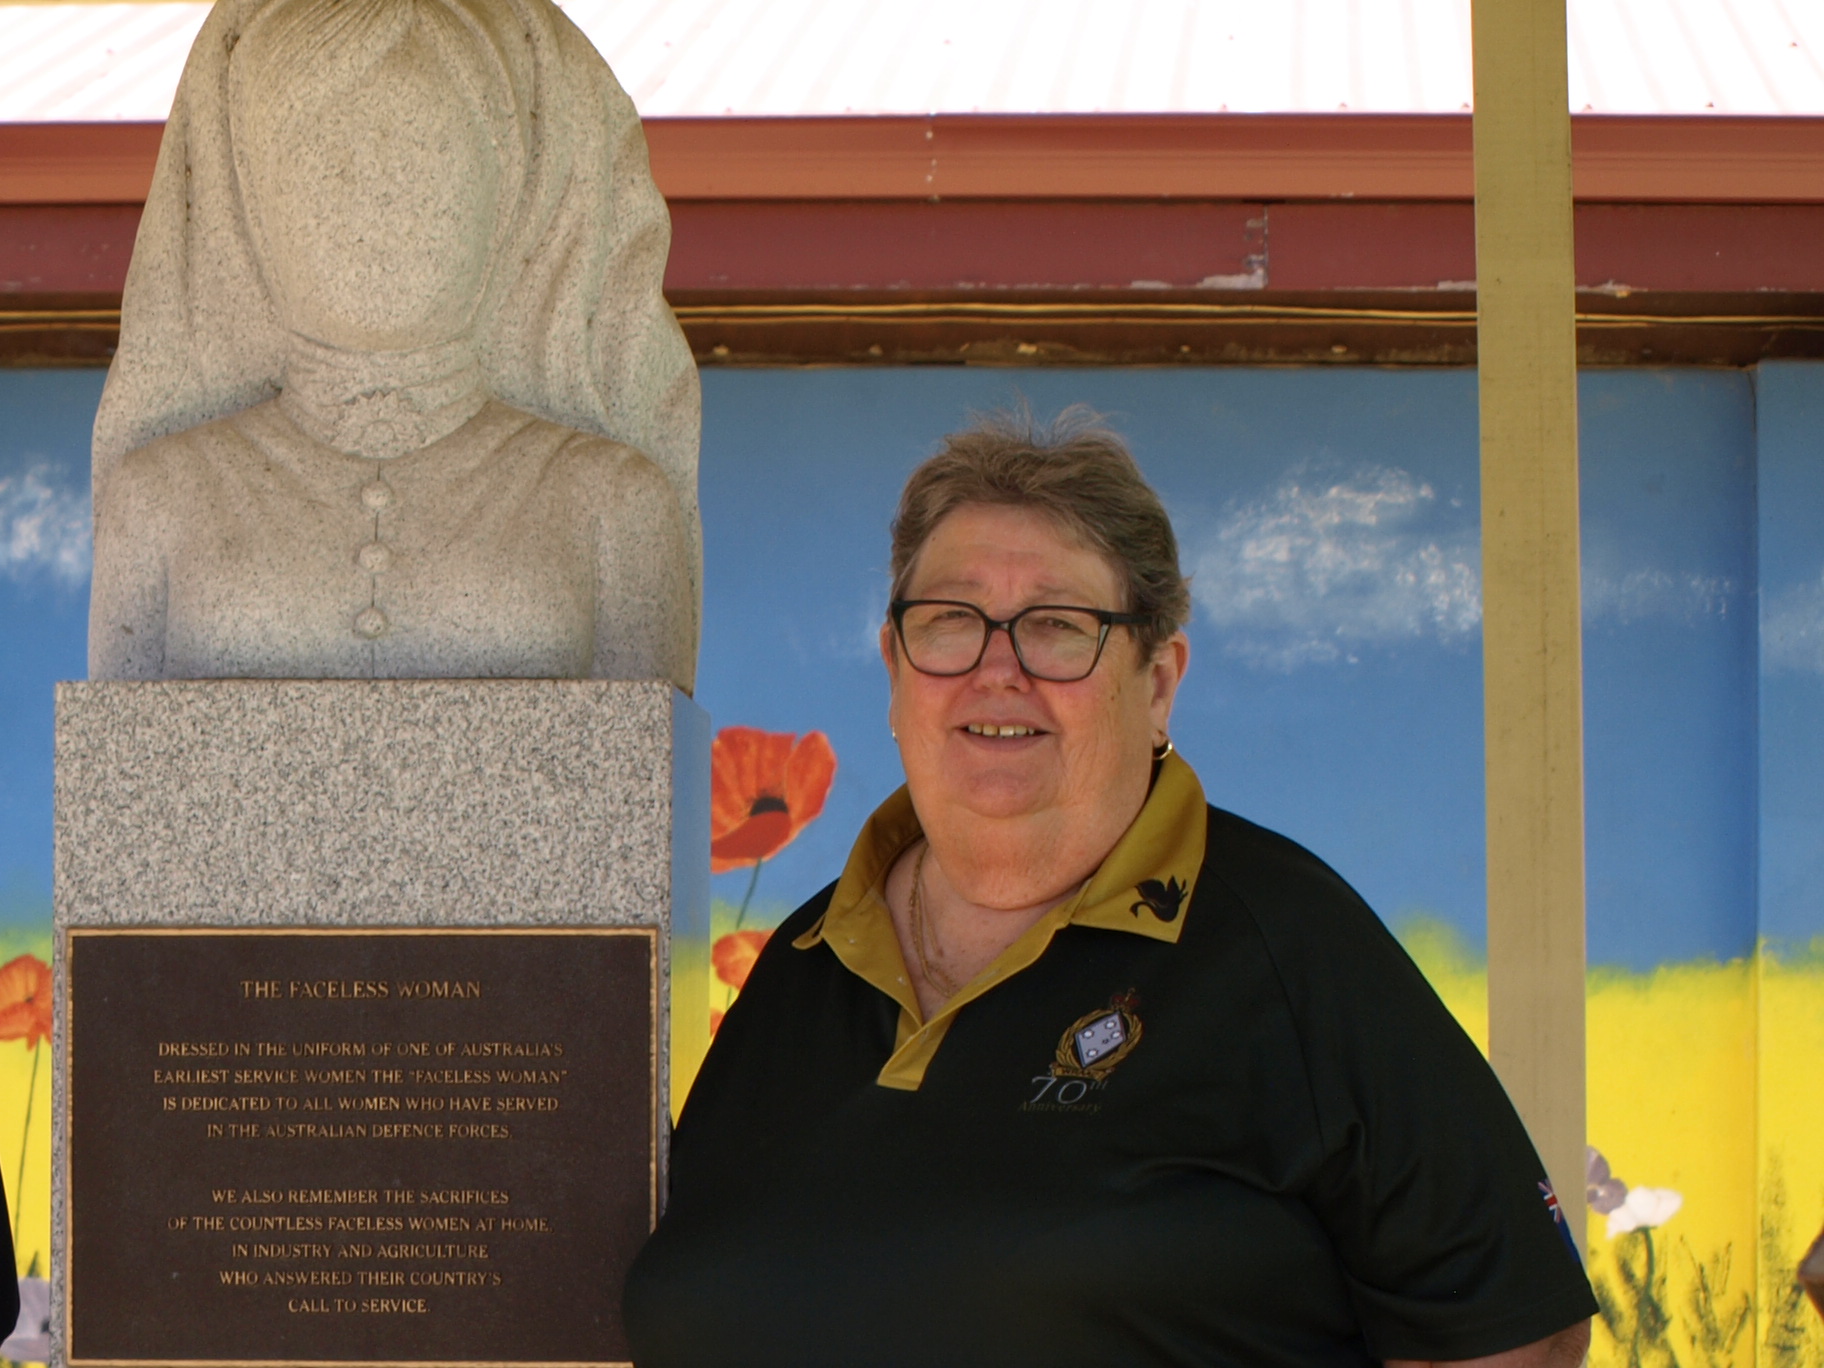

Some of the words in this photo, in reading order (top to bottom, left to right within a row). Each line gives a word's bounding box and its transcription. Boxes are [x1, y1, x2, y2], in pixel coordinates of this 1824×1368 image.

[240, 980, 282, 999] THE
[289, 980, 389, 999] FACELESS
[397, 980, 481, 999] WOMAN
[158, 1042, 230, 1057] DRESSED
[234, 1042, 251, 1056] IN
[257, 1042, 287, 1057] THE
[292, 1042, 366, 1056] UNIFORM
[371, 1042, 392, 1056] OF
[397, 1042, 430, 1056] ONE
[435, 1042, 456, 1056] OF
[153, 1069, 230, 1084] EARLIEST
[234, 1069, 298, 1084] SERVICE
[304, 1069, 366, 1084] WOMEN
[371, 1069, 403, 1084] THE
[163, 1096, 177, 1111] IS
[180, 1096, 271, 1111] DEDICATED
[277, 1096, 298, 1111] TO
[302, 1096, 333, 1111] ALL
[338, 1096, 400, 1111] WOMEN
[405, 1097, 445, 1111] WHO
[449, 1096, 492, 1111] HAVE
[496, 1096, 559, 1111] SERVED
[207, 1123, 223, 1138] IN
[228, 1123, 260, 1138] THE
[267, 1123, 367, 1138] AUSTRALIAN
[372, 1123, 444, 1138] DEFENCE
[211, 1189, 237, 1204] WE
[241, 1189, 284, 1204] ALSO
[288, 1189, 378, 1204] REMEMBER
[383, 1189, 415, 1204] THE
[420, 1189, 509, 1205] SACRIFICES
[167, 1216, 187, 1230] OF
[192, 1215, 225, 1231] THE
[229, 1216, 323, 1231] COUNTLESS
[328, 1216, 404, 1231] FACELESS
[408, 1217, 470, 1231] WOMEN
[475, 1217, 496, 1232] AT
[232, 1243, 250, 1258] IN
[253, 1243, 330, 1258] INDUSTRY
[338, 1244, 373, 1259] AND
[377, 1244, 489, 1259] AGRICULTURE
[219, 1270, 259, 1286] WHO
[263, 1270, 352, 1286] ANSWERED
[357, 1271, 405, 1286] THEIR
[287, 1298, 330, 1313] CALL
[334, 1298, 357, 1313] TO
